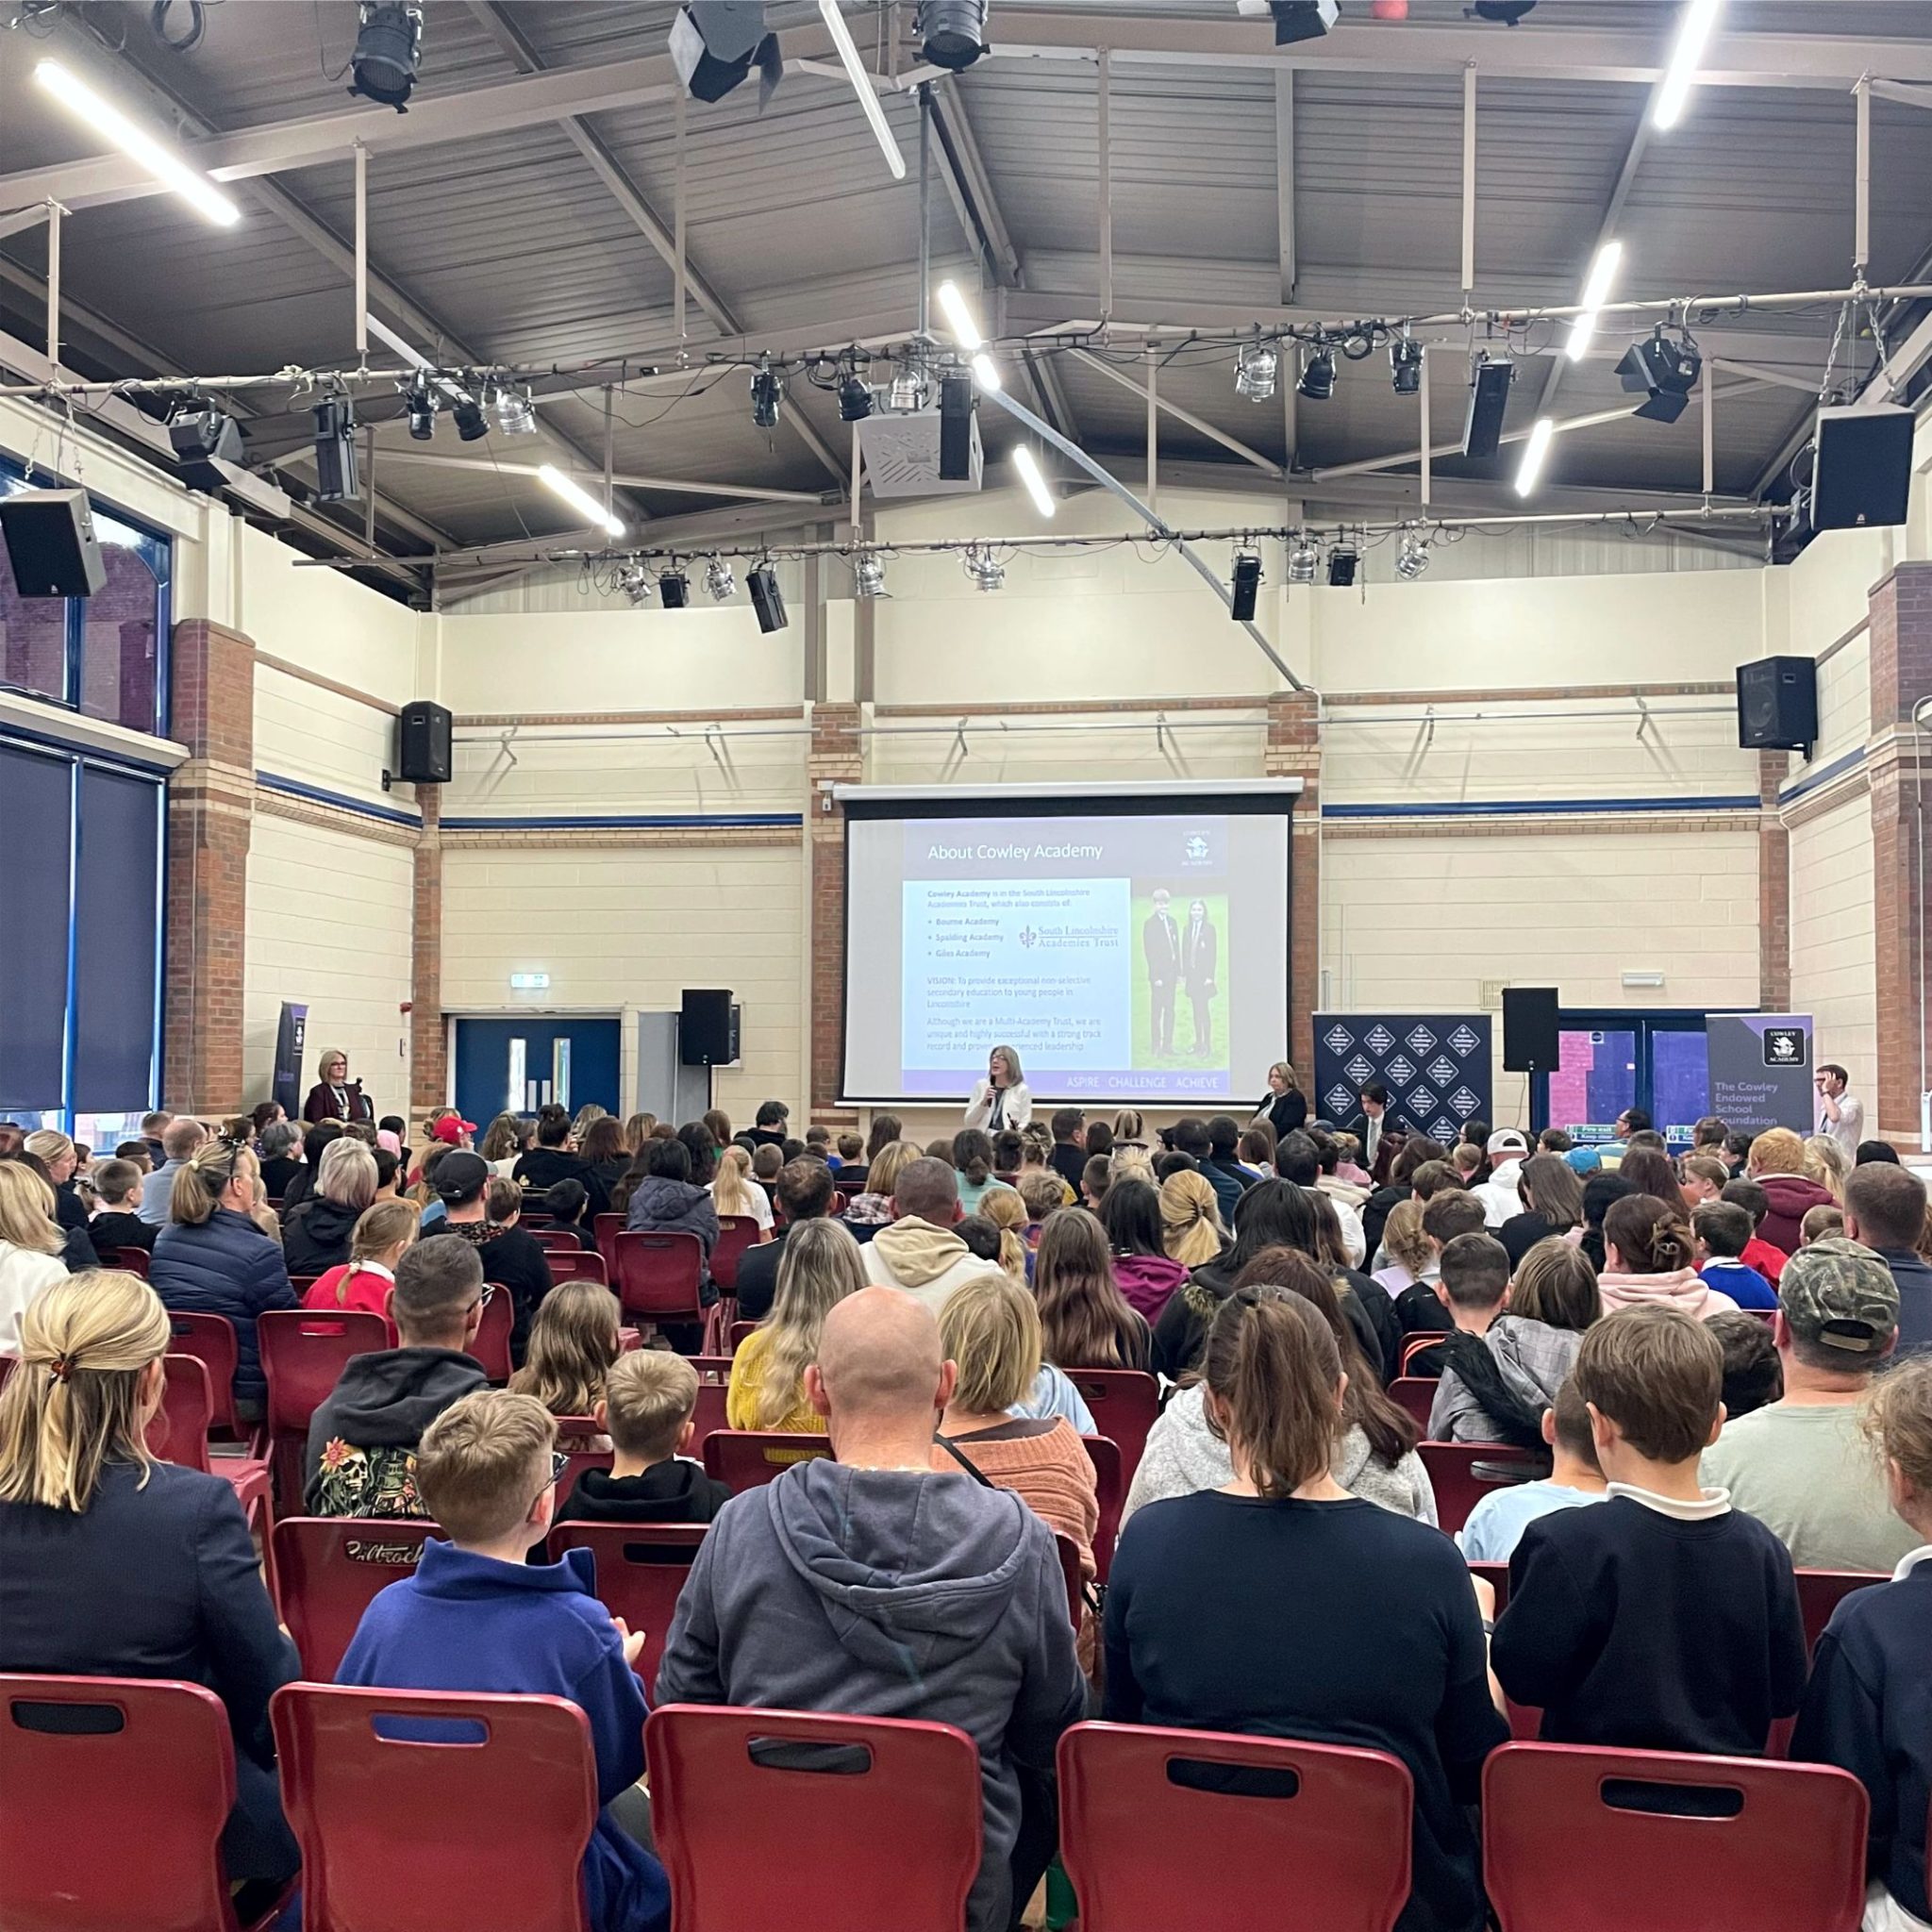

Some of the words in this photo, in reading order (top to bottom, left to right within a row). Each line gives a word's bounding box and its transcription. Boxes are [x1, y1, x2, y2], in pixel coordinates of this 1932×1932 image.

[927, 845, 973, 859] About
[976, 844, 1030, 861] Cowley
[1034, 843, 1103, 860] Academy
[1046, 888, 1091, 896] Lincolnshire
[936, 918, 963, 926] Bourne
[965, 918, 999, 927] Academy
[1038, 926, 1063, 935] South
[1065, 925, 1118, 935] Lincolnshire
[936, 934, 968, 943] Spalding
[969, 934, 1004, 943] Academy
[1038, 939, 1091, 947] Academies
[1094, 938, 1119, 947] Trust
[956, 949, 991, 958] Academy
[968, 977, 996, 986] provide
[997, 976, 1040, 986] exceptional
[1014, 990, 1037, 998] young
[1038, 989, 1063, 998] people
[927, 1018, 960, 1027] Although
[1053, 1018, 1074, 1027] Trust,
[954, 1029, 968, 1038] and
[970, 1029, 991, 1040] highly
[1033, 1029, 1049, 1038] with
[1058, 1029, 1081, 1040] strong
[927, 1041, 951, 1050] record
[953, 1041, 967, 1050] and
[1044, 1041, 1084, 1052] leadership
[1067, 1077, 1100, 1088] ASPIRE
[1108, 1077, 1167, 1088] CHALLENGE
[1175, 1077, 1219, 1088] ACHIEVE
[1714, 1082, 1735, 1091] The
[1738, 1082, 1778, 1094] Cowley
[1716, 1093, 1766, 1102] Endowed
[1716, 1105, 1753, 1113] School
